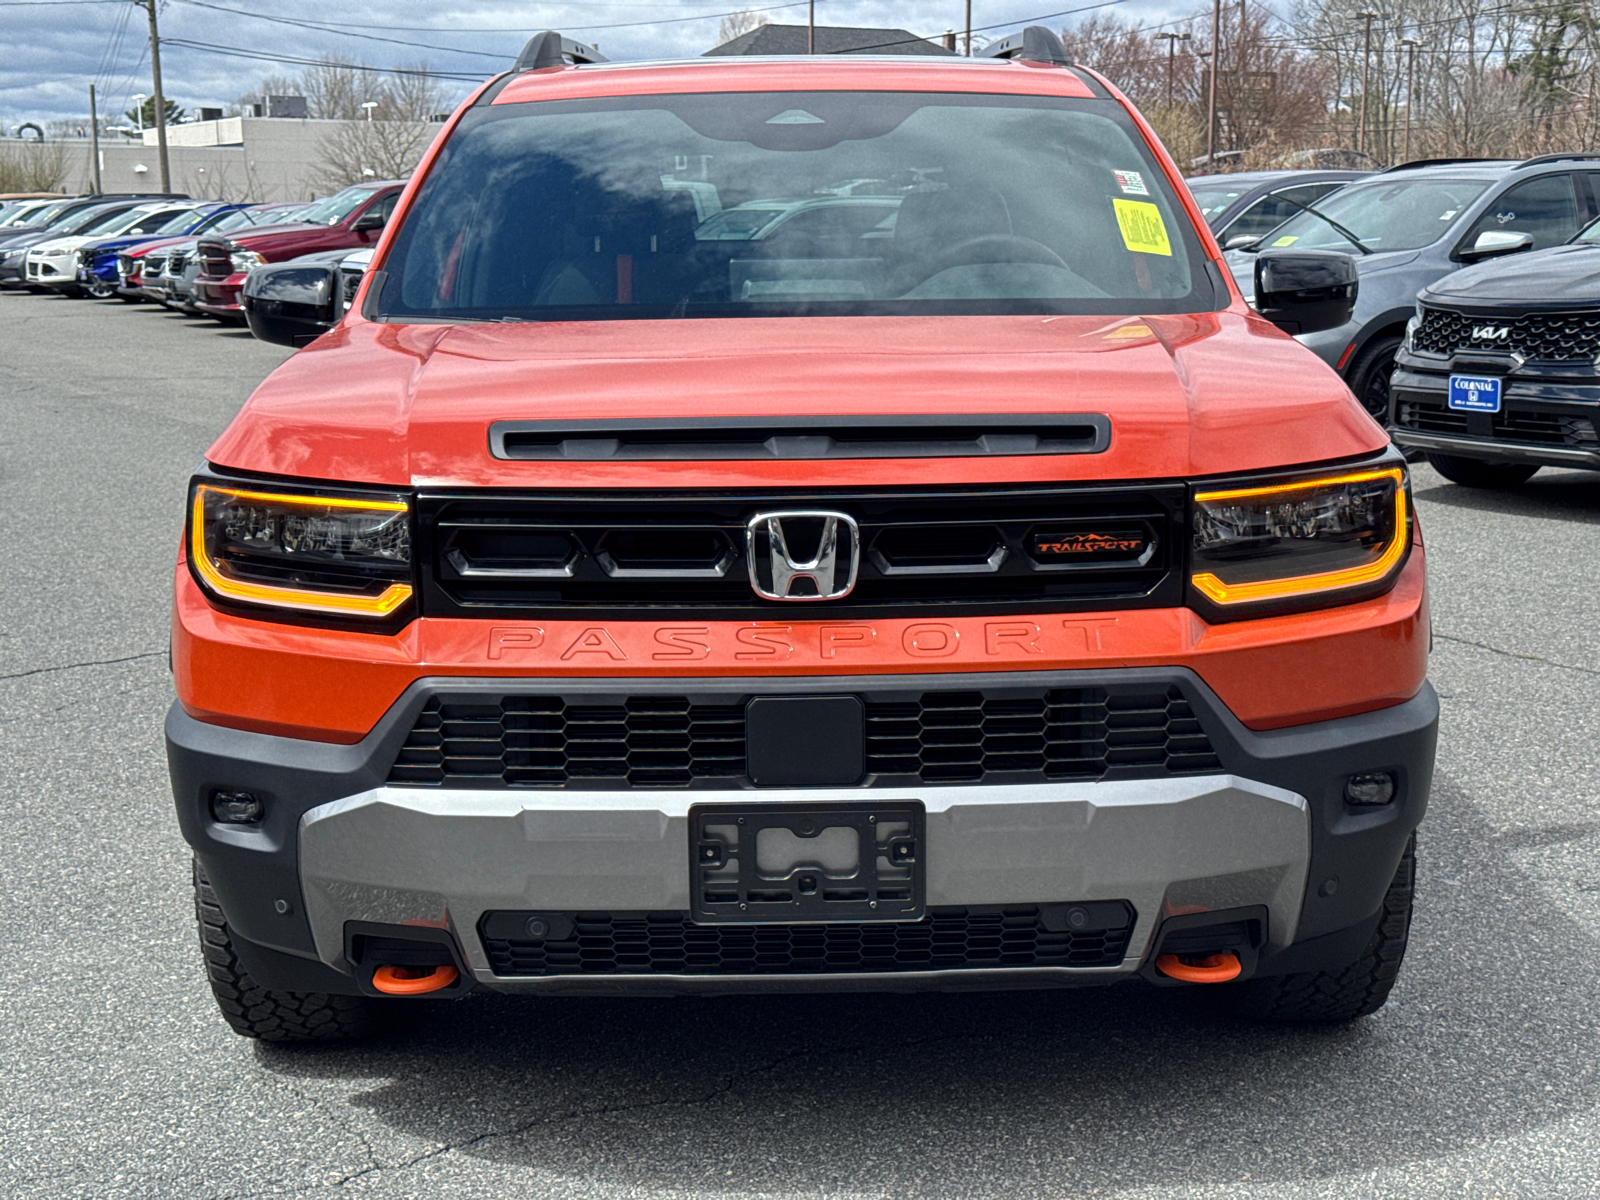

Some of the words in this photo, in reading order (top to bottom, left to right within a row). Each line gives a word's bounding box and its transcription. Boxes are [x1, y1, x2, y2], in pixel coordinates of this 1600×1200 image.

[1472, 326, 1510, 339] KIA
[1454, 378, 1495, 392] COLONIAL
[1038, 540, 1141, 553] TRAILSPORT
[487, 617, 1119, 661] PASSPORT
